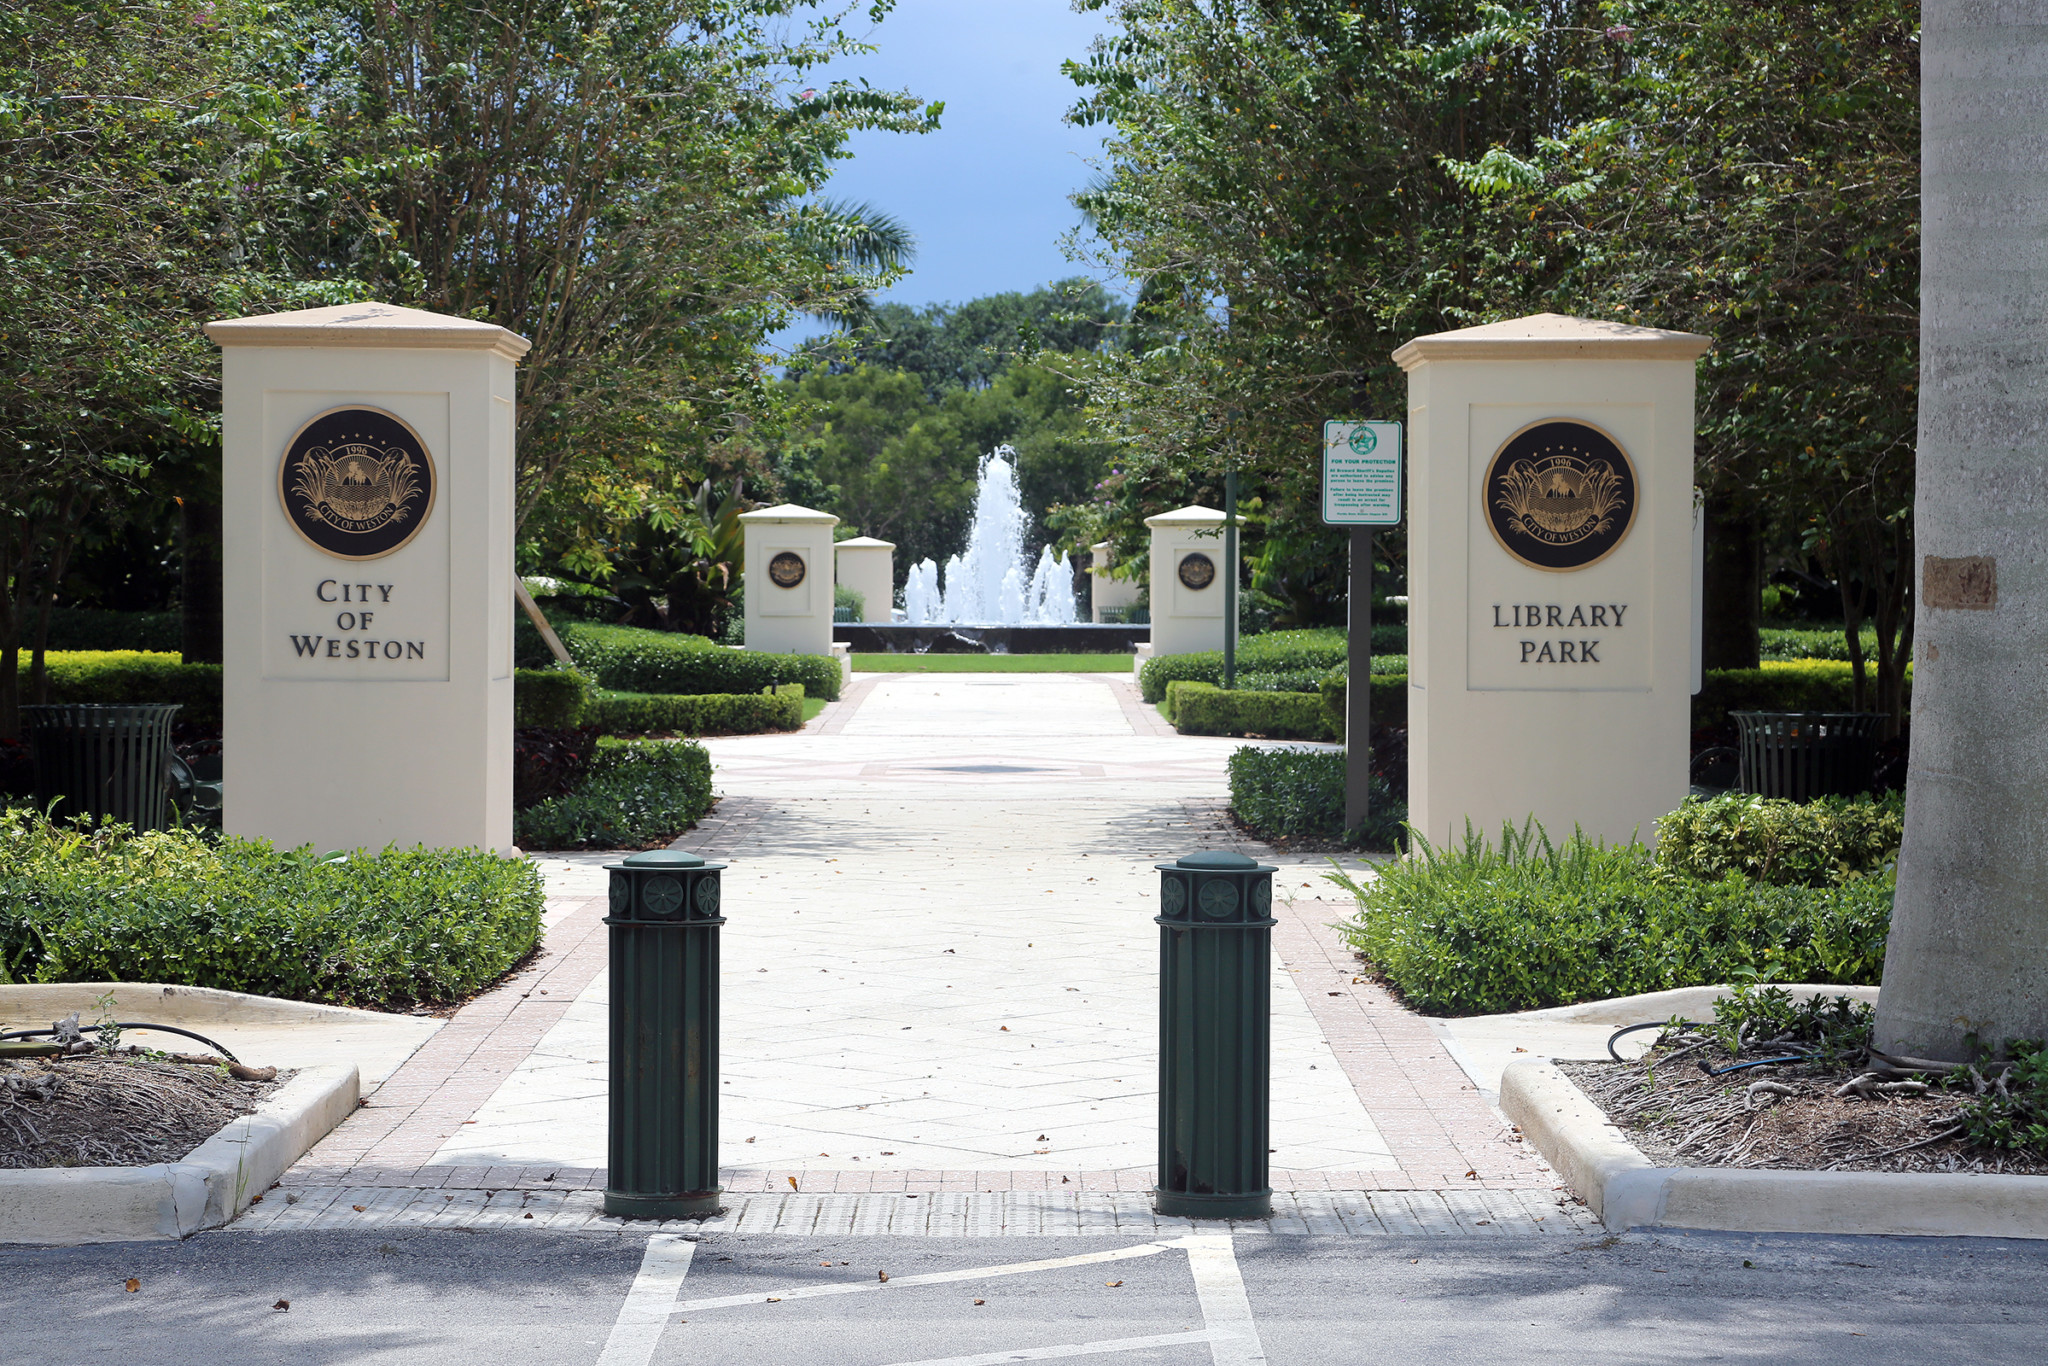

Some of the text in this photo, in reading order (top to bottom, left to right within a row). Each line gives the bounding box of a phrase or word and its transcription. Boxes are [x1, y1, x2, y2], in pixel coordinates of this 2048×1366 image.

[345, 446, 368, 455] 1996
[1550, 458, 1572, 467] 1996
[320, 505, 394, 530] CITY OF WESTON
[1524, 517, 1597, 542] CITY OF WESTON
[336, 611, 374, 631] OF
[1492, 604, 1628, 628] LIBRARY
[1519, 640, 1600, 663] PARK
